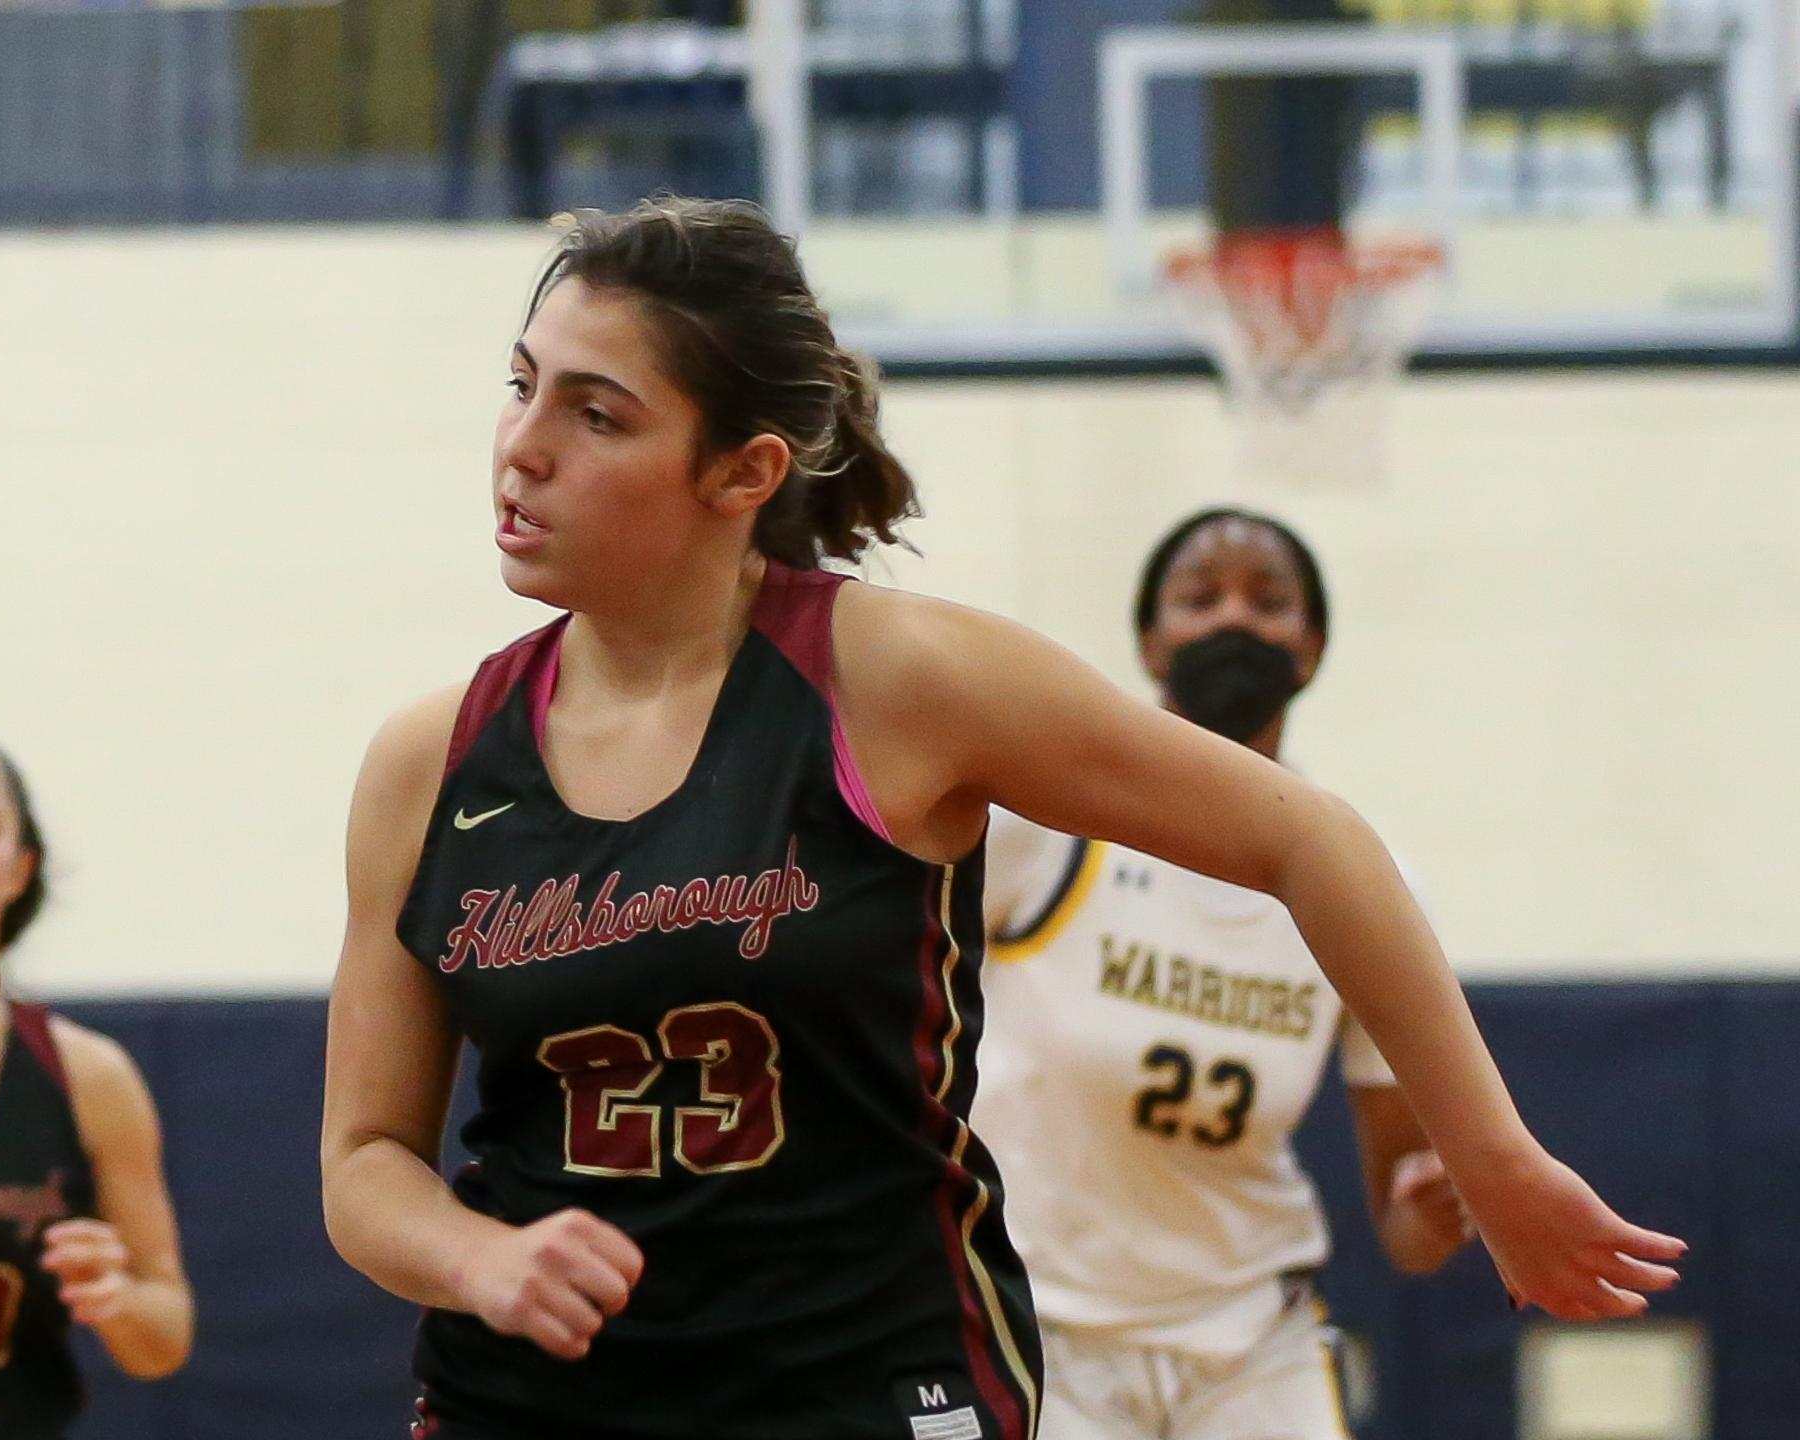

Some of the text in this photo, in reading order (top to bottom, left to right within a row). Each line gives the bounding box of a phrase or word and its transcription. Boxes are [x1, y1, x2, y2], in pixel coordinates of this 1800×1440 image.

[439, 835, 819, 972] Hillsborough
[537, 1001, 785, 1178] 23
[1133, 1041, 1258, 1148] 23
[917, 1383, 949, 1408] M
